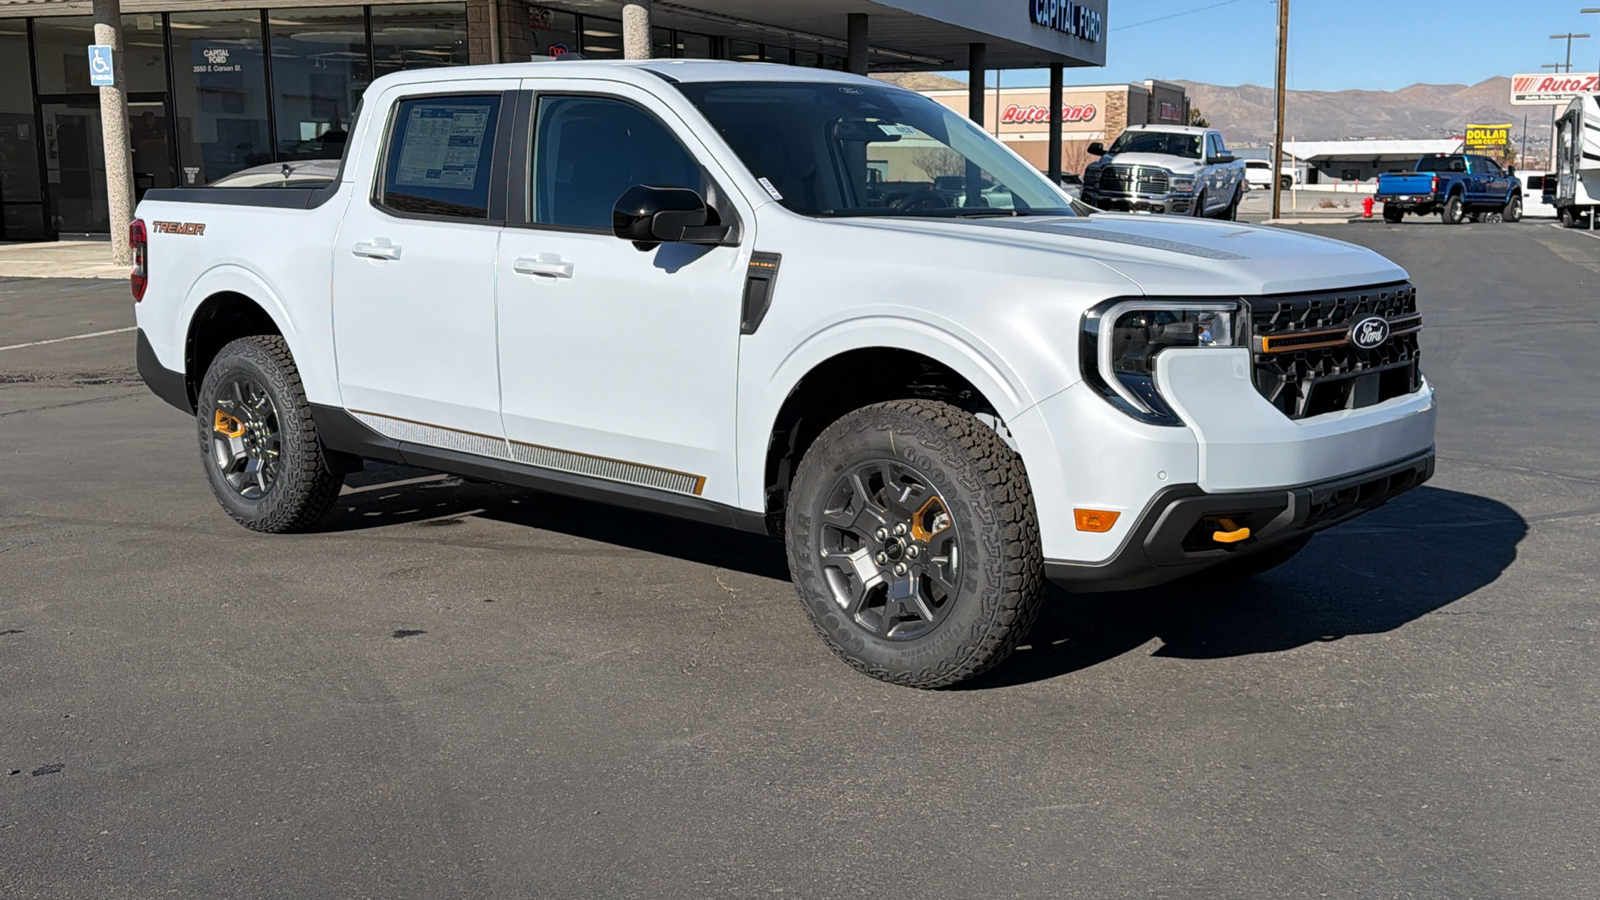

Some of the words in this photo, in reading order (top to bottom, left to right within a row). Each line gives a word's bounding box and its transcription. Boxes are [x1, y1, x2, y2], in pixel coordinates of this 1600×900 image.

[1035, 0, 1076, 34] CAPITAL
[1080, 5, 1101, 42] FORD
[203, 49, 229, 57] CAPITAL
[1001, 105, 1094, 121] Autoone
[1466, 130, 1507, 139] DOLLAR
[152, 221, 206, 236] TREMOR
[1360, 321, 1384, 344] Ford
